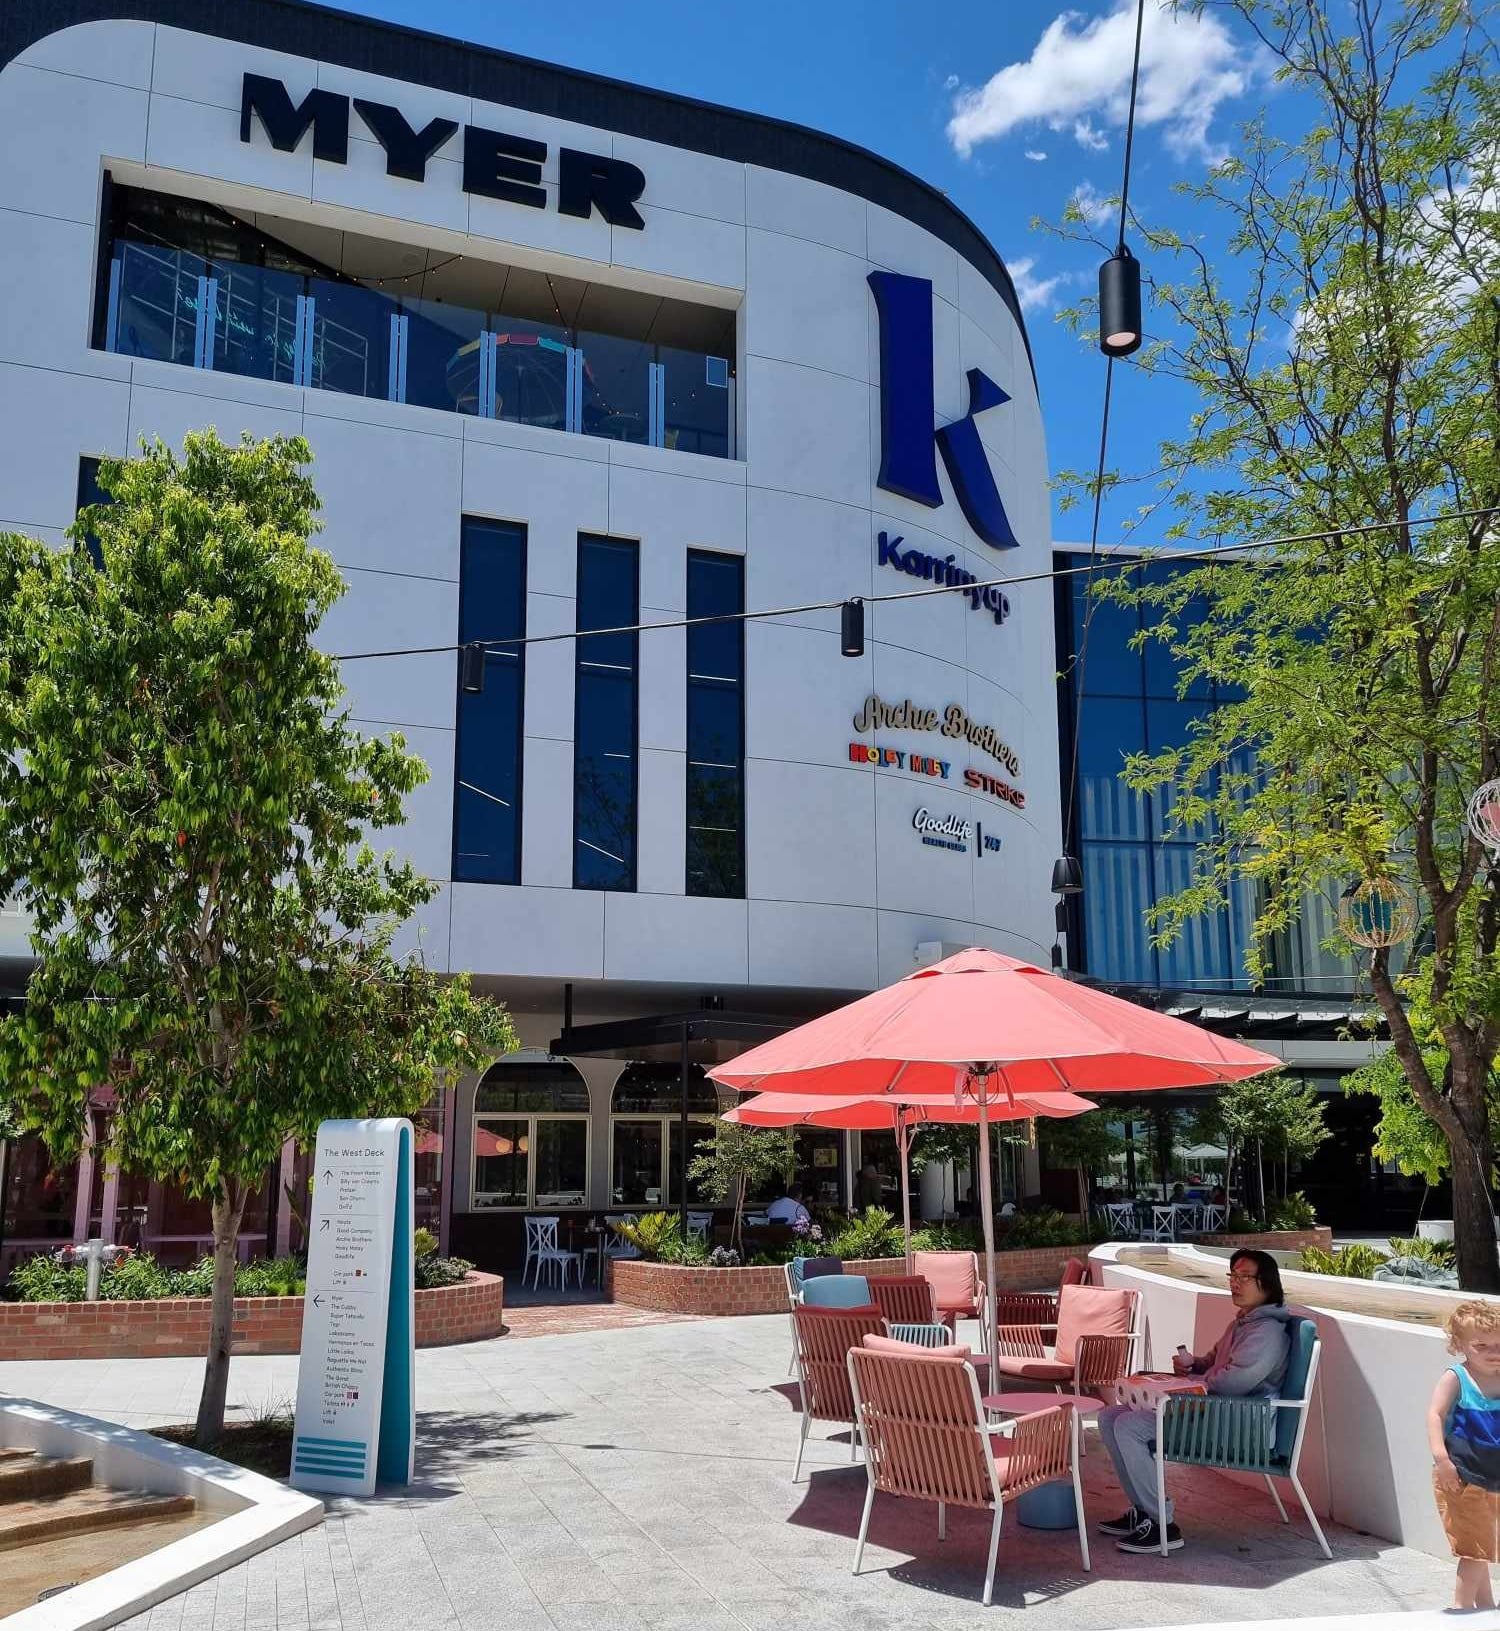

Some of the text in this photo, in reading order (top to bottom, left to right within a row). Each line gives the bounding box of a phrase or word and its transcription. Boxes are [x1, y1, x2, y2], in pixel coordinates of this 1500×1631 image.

[240, 72, 646, 230] MYER
[877, 531, 1011, 624] Karrinyup
[853, 694, 1022, 778] Archie Brothers
[964, 767, 1025, 810] STRIKE
[912, 806, 974, 842] Goodlife
[324, 1148, 385, 1157] The West Deck
